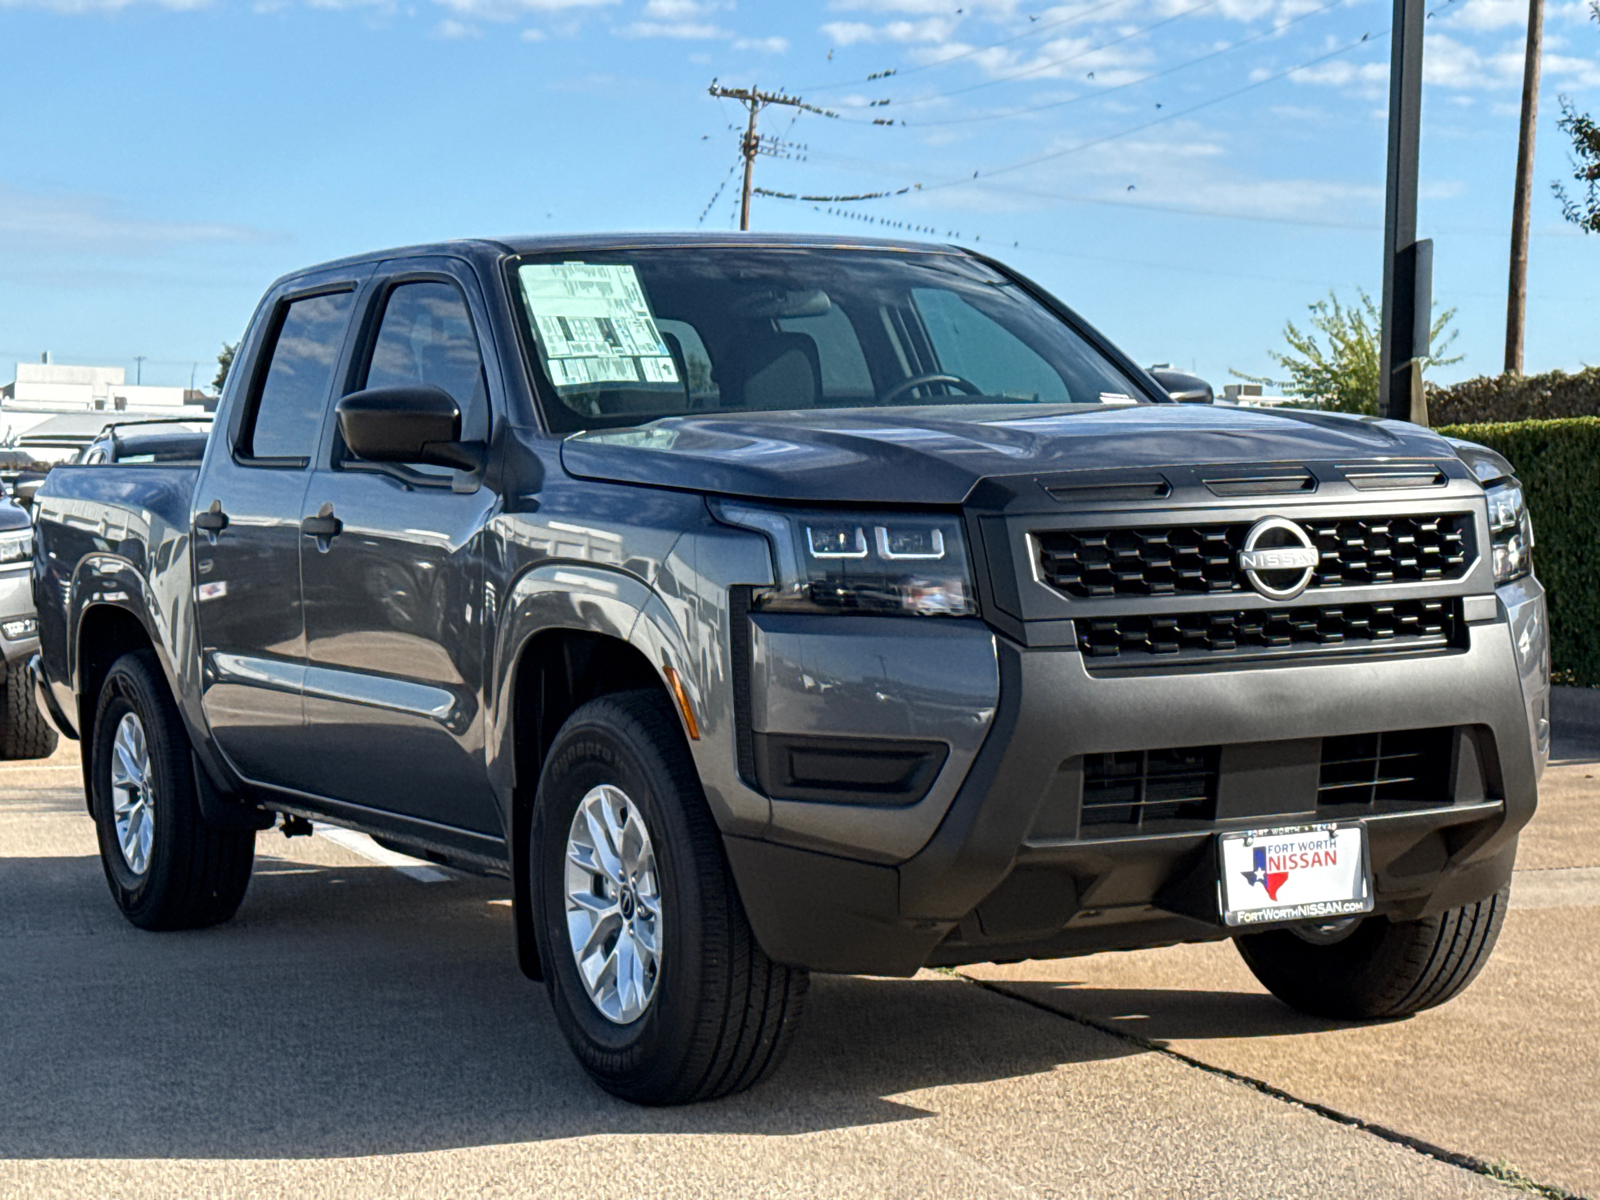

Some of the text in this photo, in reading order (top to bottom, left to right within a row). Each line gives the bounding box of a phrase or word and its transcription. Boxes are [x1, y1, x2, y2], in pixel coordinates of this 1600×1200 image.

[1241, 552, 1318, 568] NISSAN
[1271, 826, 1300, 835] WORTH
[1268, 839, 1337, 854] FORT WORTH
[1268, 850, 1337, 872] NISSAN
